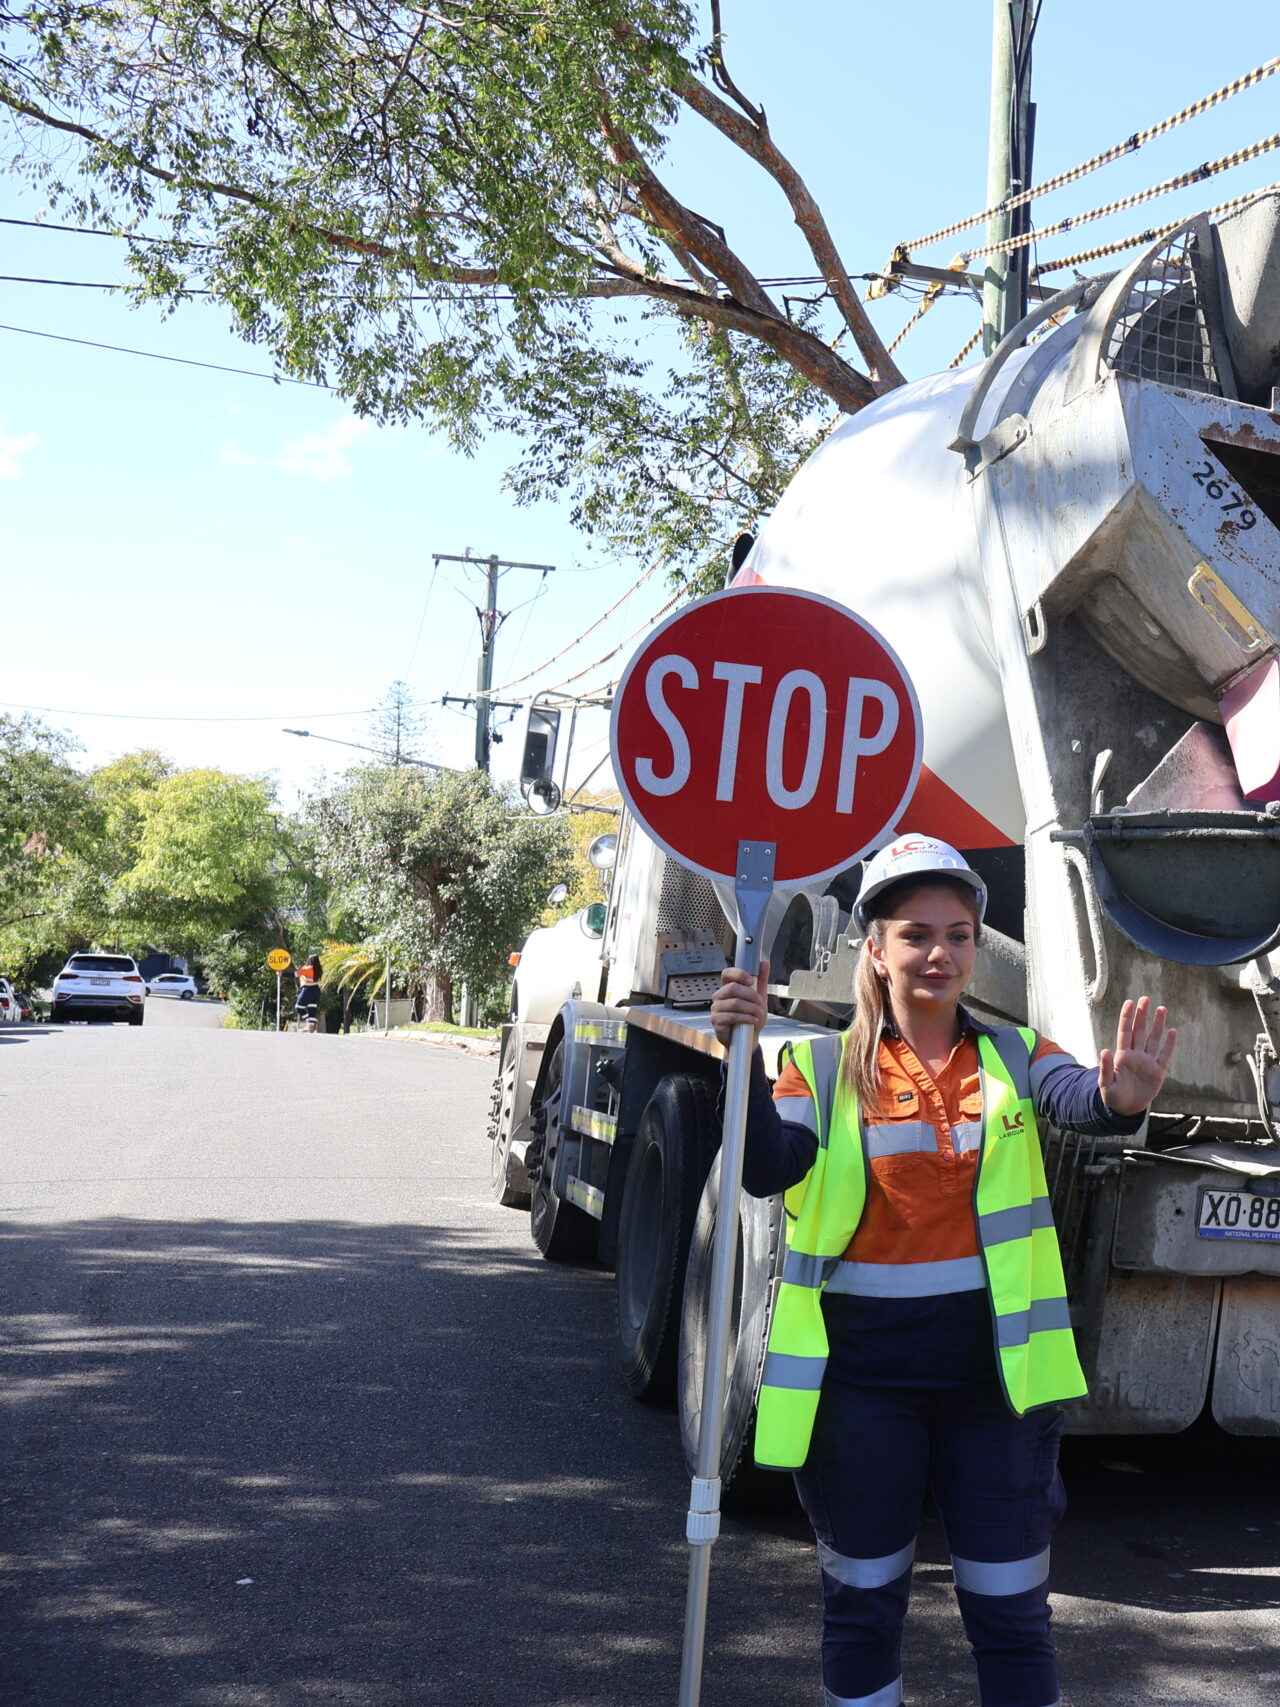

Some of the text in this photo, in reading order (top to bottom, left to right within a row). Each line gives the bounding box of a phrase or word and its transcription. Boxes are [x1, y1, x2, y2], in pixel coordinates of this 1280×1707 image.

[1192, 461, 1257, 531] 2679
[634, 654, 900, 814] STOP
[269, 956, 289, 964] SLOW
[999, 1129, 1024, 1139] LABOUR
[1224, 1230, 1251, 1239] NATIONAL
[1252, 1231, 1270, 1239] HEAVY
